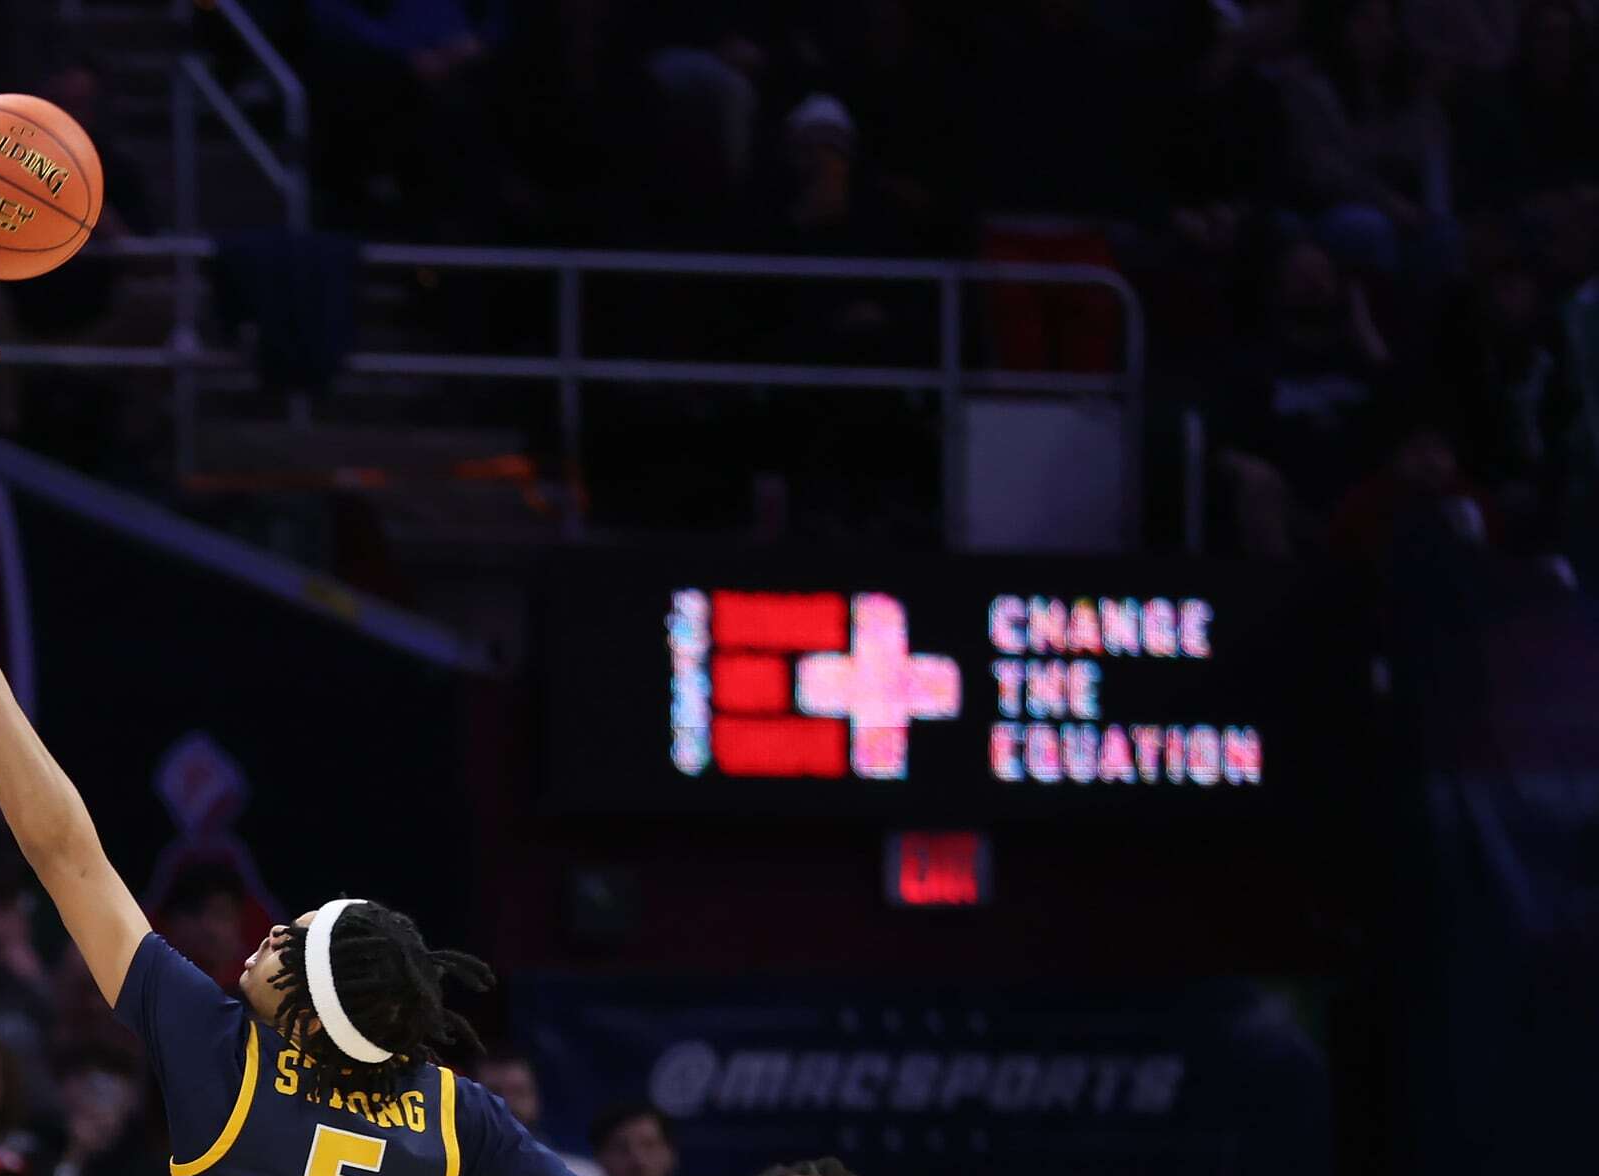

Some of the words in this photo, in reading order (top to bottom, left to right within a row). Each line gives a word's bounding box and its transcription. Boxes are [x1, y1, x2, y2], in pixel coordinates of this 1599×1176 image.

[990, 594, 1214, 658] CHANGE
[991, 657, 1103, 720] THE
[989, 720, 1264, 786] EQUATION
[649, 1040, 1185, 1117] @MACSPORTS
